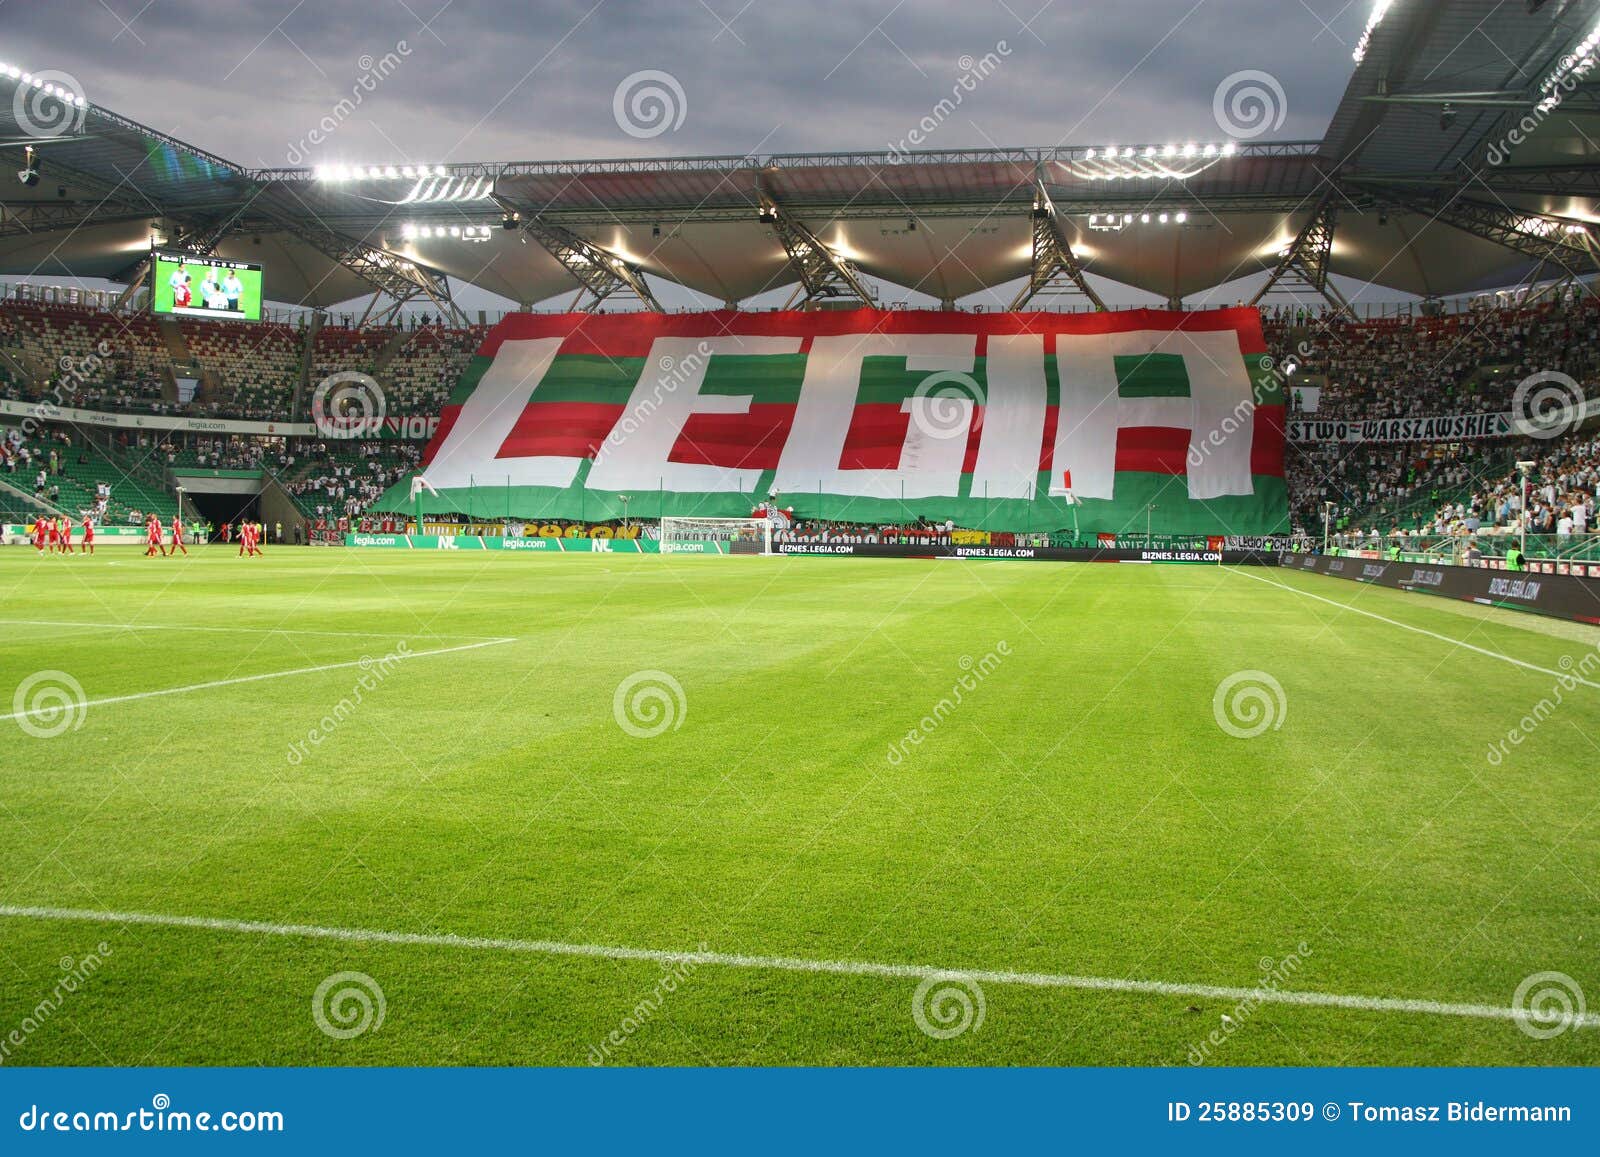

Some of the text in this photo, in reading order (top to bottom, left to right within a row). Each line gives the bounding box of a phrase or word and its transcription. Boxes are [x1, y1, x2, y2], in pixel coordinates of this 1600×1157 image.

[426, 329, 1254, 499] LEGIA
[188, 421, 226, 430] legia.com
[354, 535, 395, 546] legia.com
[502, 538, 546, 550] legia.com
[779, 545, 854, 554] BIZNES.LEGIA.COM
[956, 548, 1034, 557] BIZNES.LEGIA.COM
